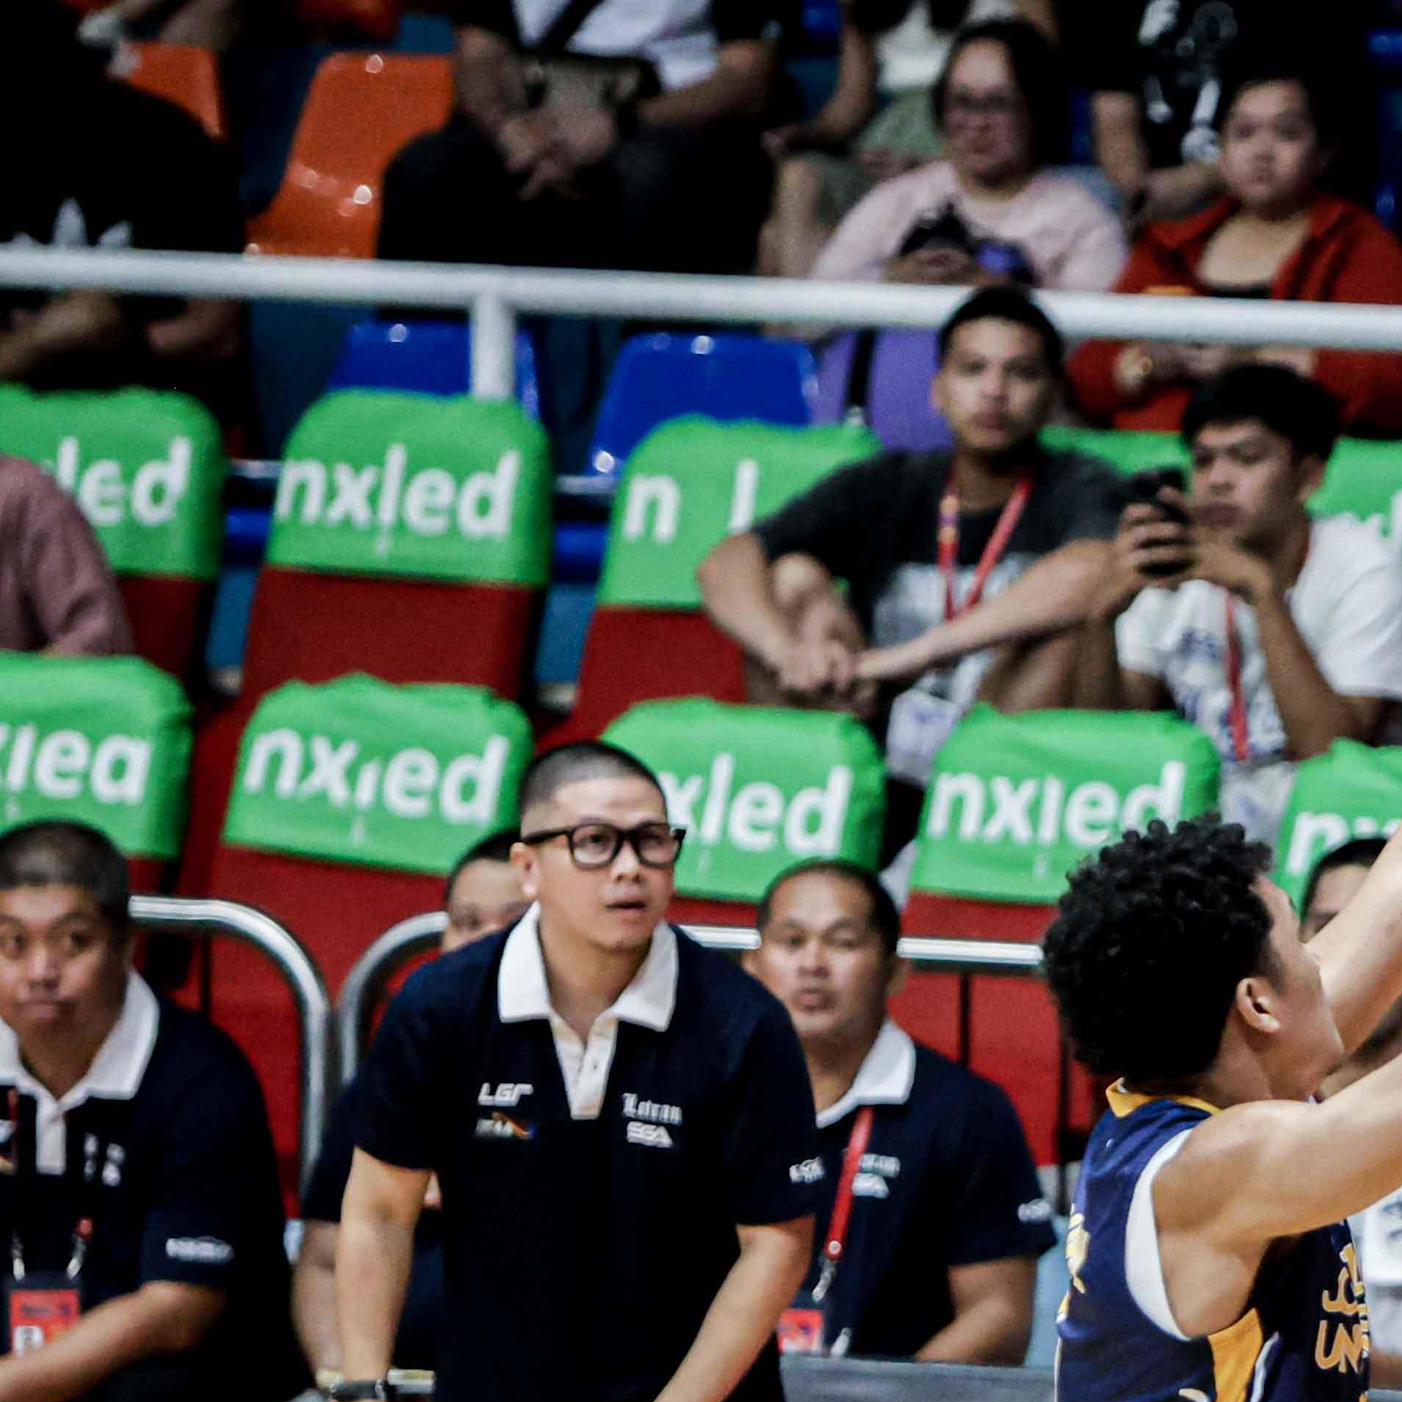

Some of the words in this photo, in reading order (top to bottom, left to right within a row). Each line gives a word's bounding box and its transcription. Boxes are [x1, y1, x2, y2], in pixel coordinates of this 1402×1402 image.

[57, 436, 192, 527] led
[276, 443, 521, 540] nxled
[658, 753, 854, 858] xled
